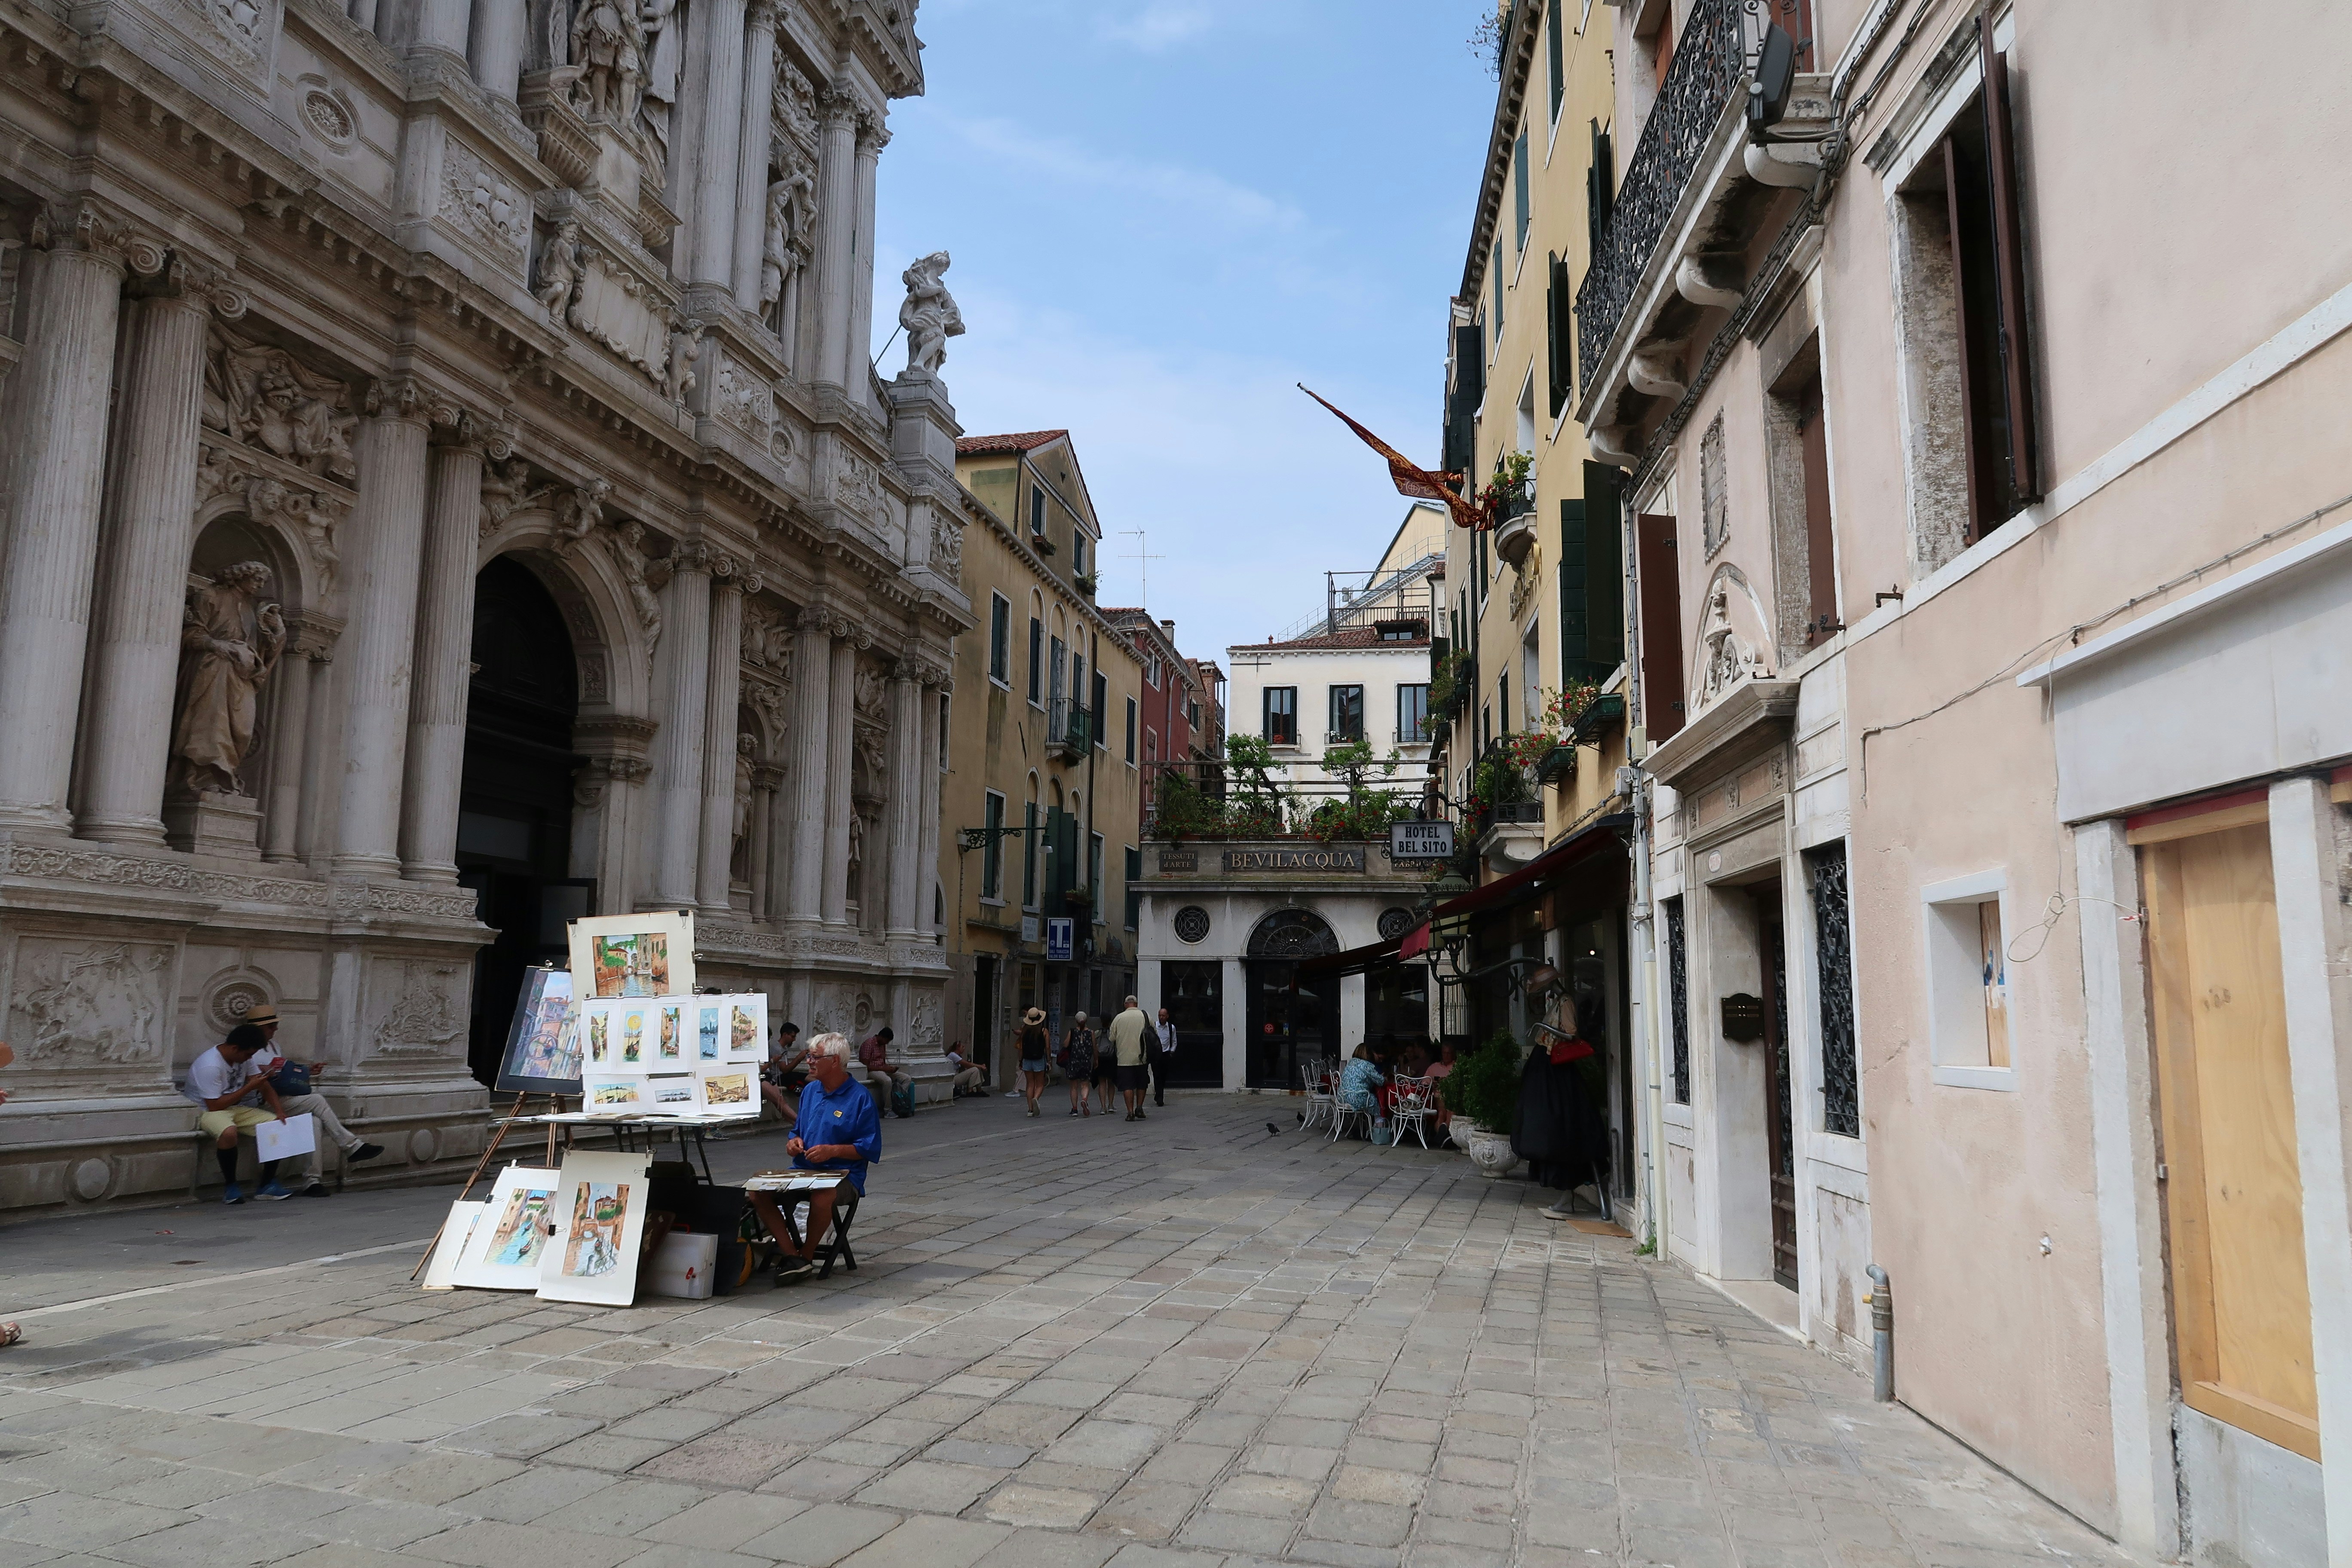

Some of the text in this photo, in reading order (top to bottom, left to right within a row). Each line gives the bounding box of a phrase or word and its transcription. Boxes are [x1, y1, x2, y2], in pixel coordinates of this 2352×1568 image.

[1406, 827, 1439, 838] HOTEL
[1399, 841, 1446, 852] BEL SITO
[1231, 853, 1354, 870] BEVILACQUA
[1050, 920, 1069, 948] T
[1021, 968, 1034, 977] ATM
